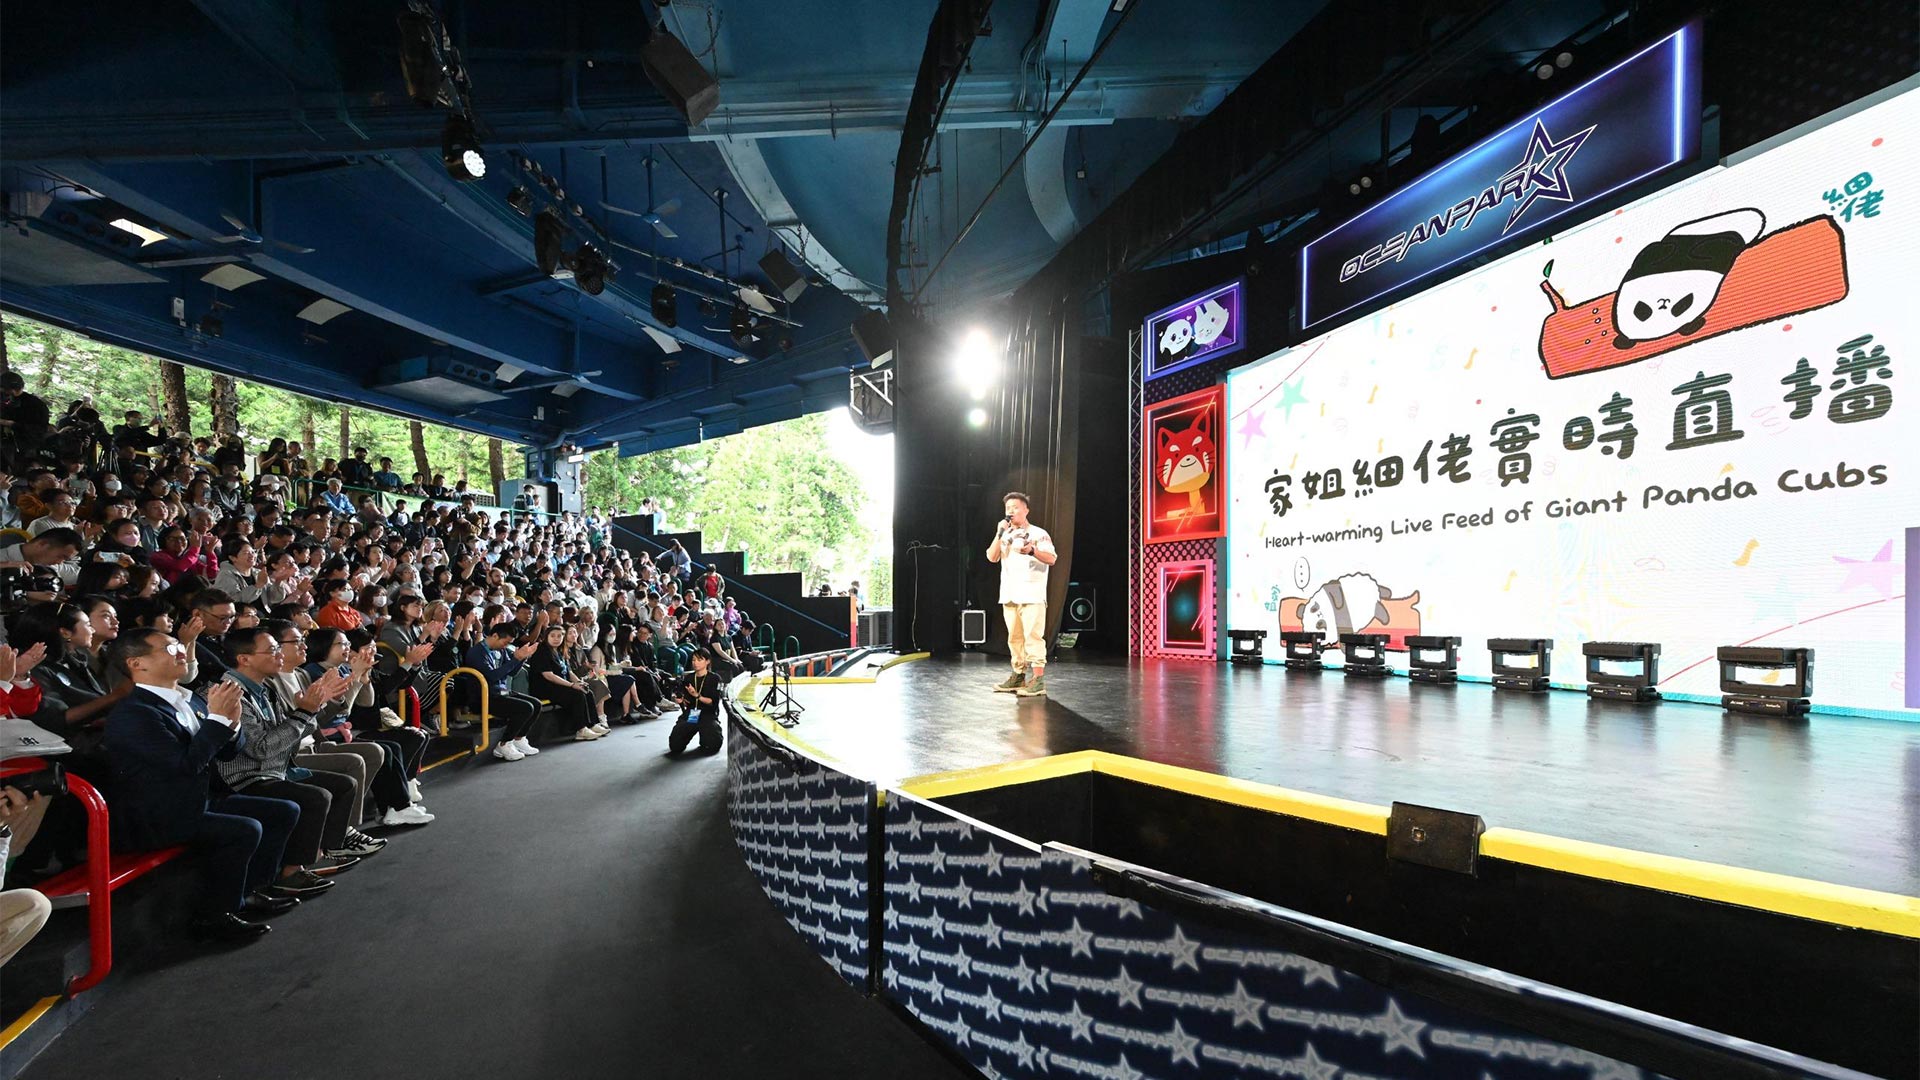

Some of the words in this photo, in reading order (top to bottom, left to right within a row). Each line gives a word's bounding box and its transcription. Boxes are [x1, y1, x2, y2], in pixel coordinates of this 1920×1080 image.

[1340, 152, 1558, 282] OCEANPARK
[1822, 171, 1884, 223] 細佬
[1264, 333, 1894, 518] 家姐細佬實時直播
[1266, 525, 1382, 548] Heart-warming
[1392, 519, 1432, 534] Live
[1443, 508, 1493, 529] Feed
[1505, 502, 1533, 523] of
[1546, 491, 1627, 517] Giant
[1643, 477, 1757, 508] Panda
[1778, 462, 1887, 492] Cubs
